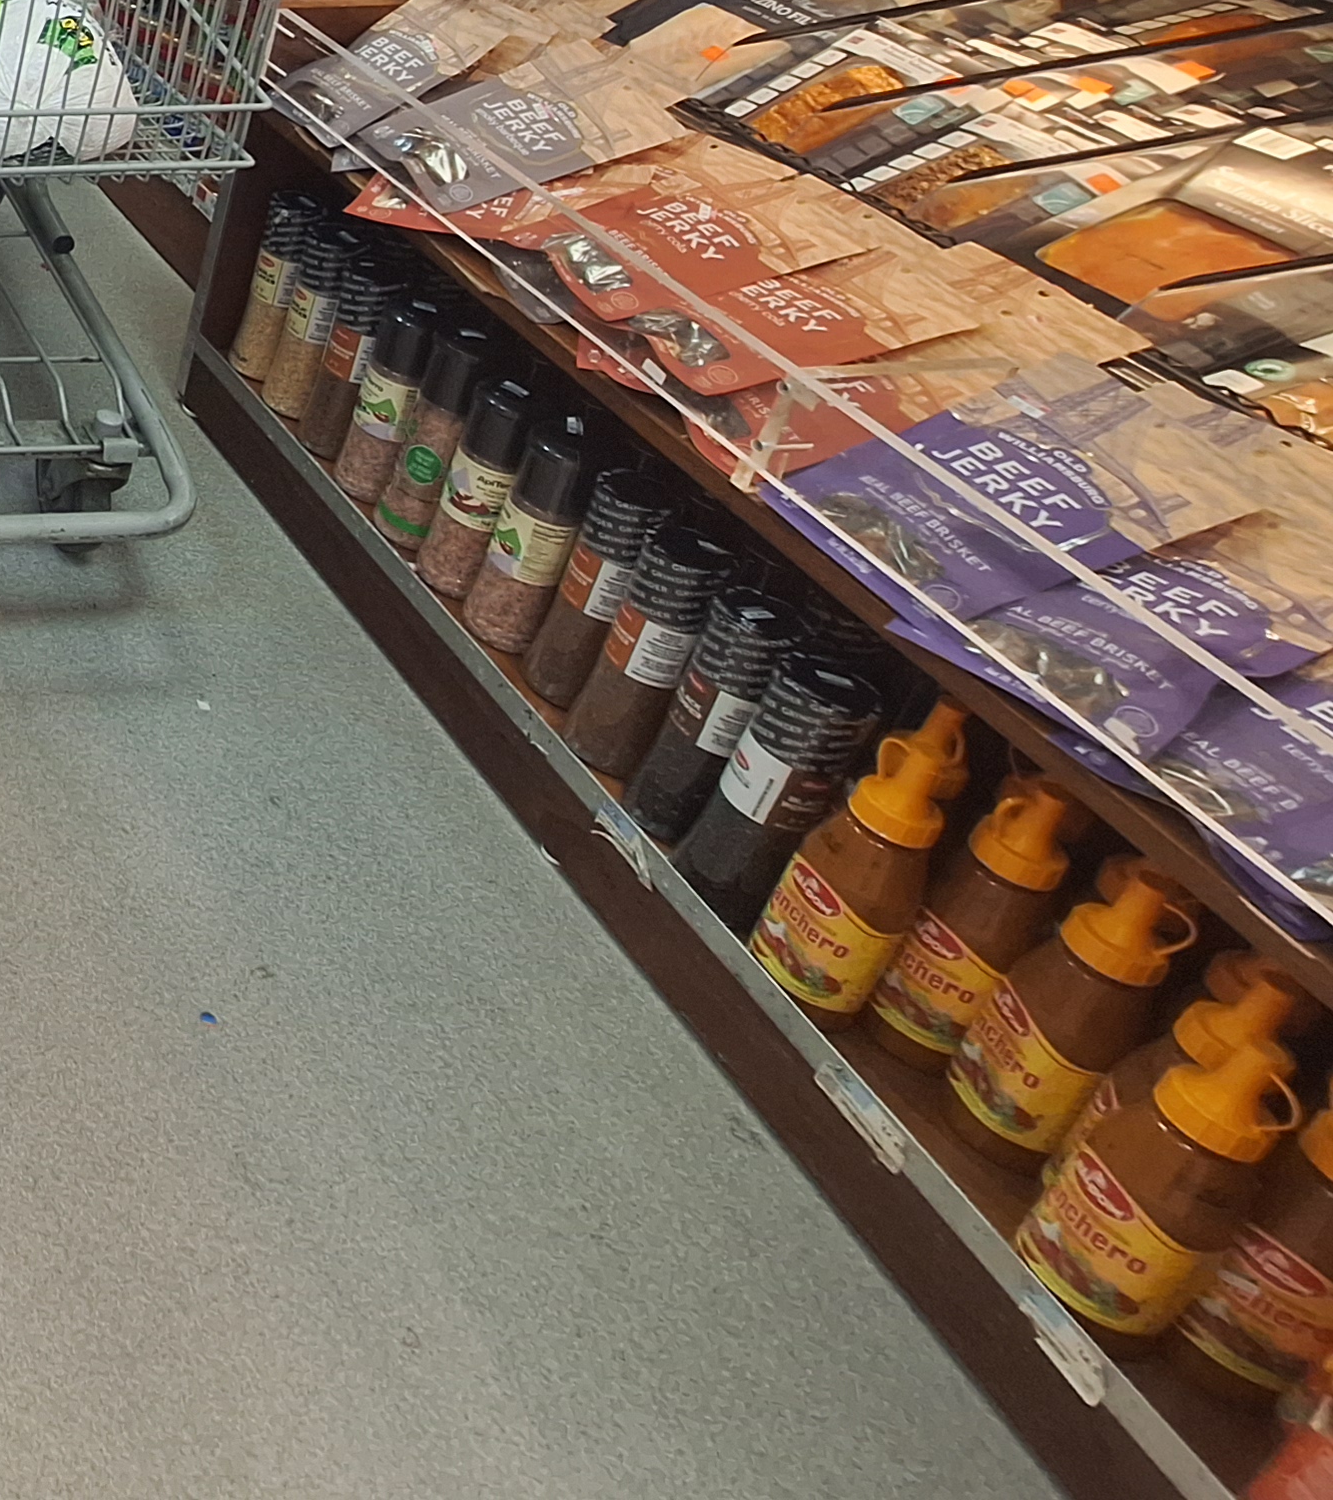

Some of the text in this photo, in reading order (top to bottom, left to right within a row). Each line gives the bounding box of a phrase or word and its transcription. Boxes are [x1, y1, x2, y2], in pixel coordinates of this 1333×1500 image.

[370, 35, 426, 69] BEEF
[482, 101, 554, 157] JERKY
[505, 97, 567, 146] BEEF
[636, 206, 726, 261] JERKY
[663, 200, 741, 249] BEEF
[740, 284, 830, 333] ERKY
[967, 440, 1083, 511] BEEF
[996, 430, 1107, 507] WILLIAMSBURG
[1052, 448, 1088, 474] OLD
[930, 448, 1065, 530] JERKY
[888, 490, 930, 521] BEEF
[924, 516, 994, 573] BRISKET
[1089, 637, 1176, 692] BRISKET
[772, 884, 851, 960] anchero
[901, 950, 977, 1005] chero
[1050, 1185, 1148, 1276] nchero
